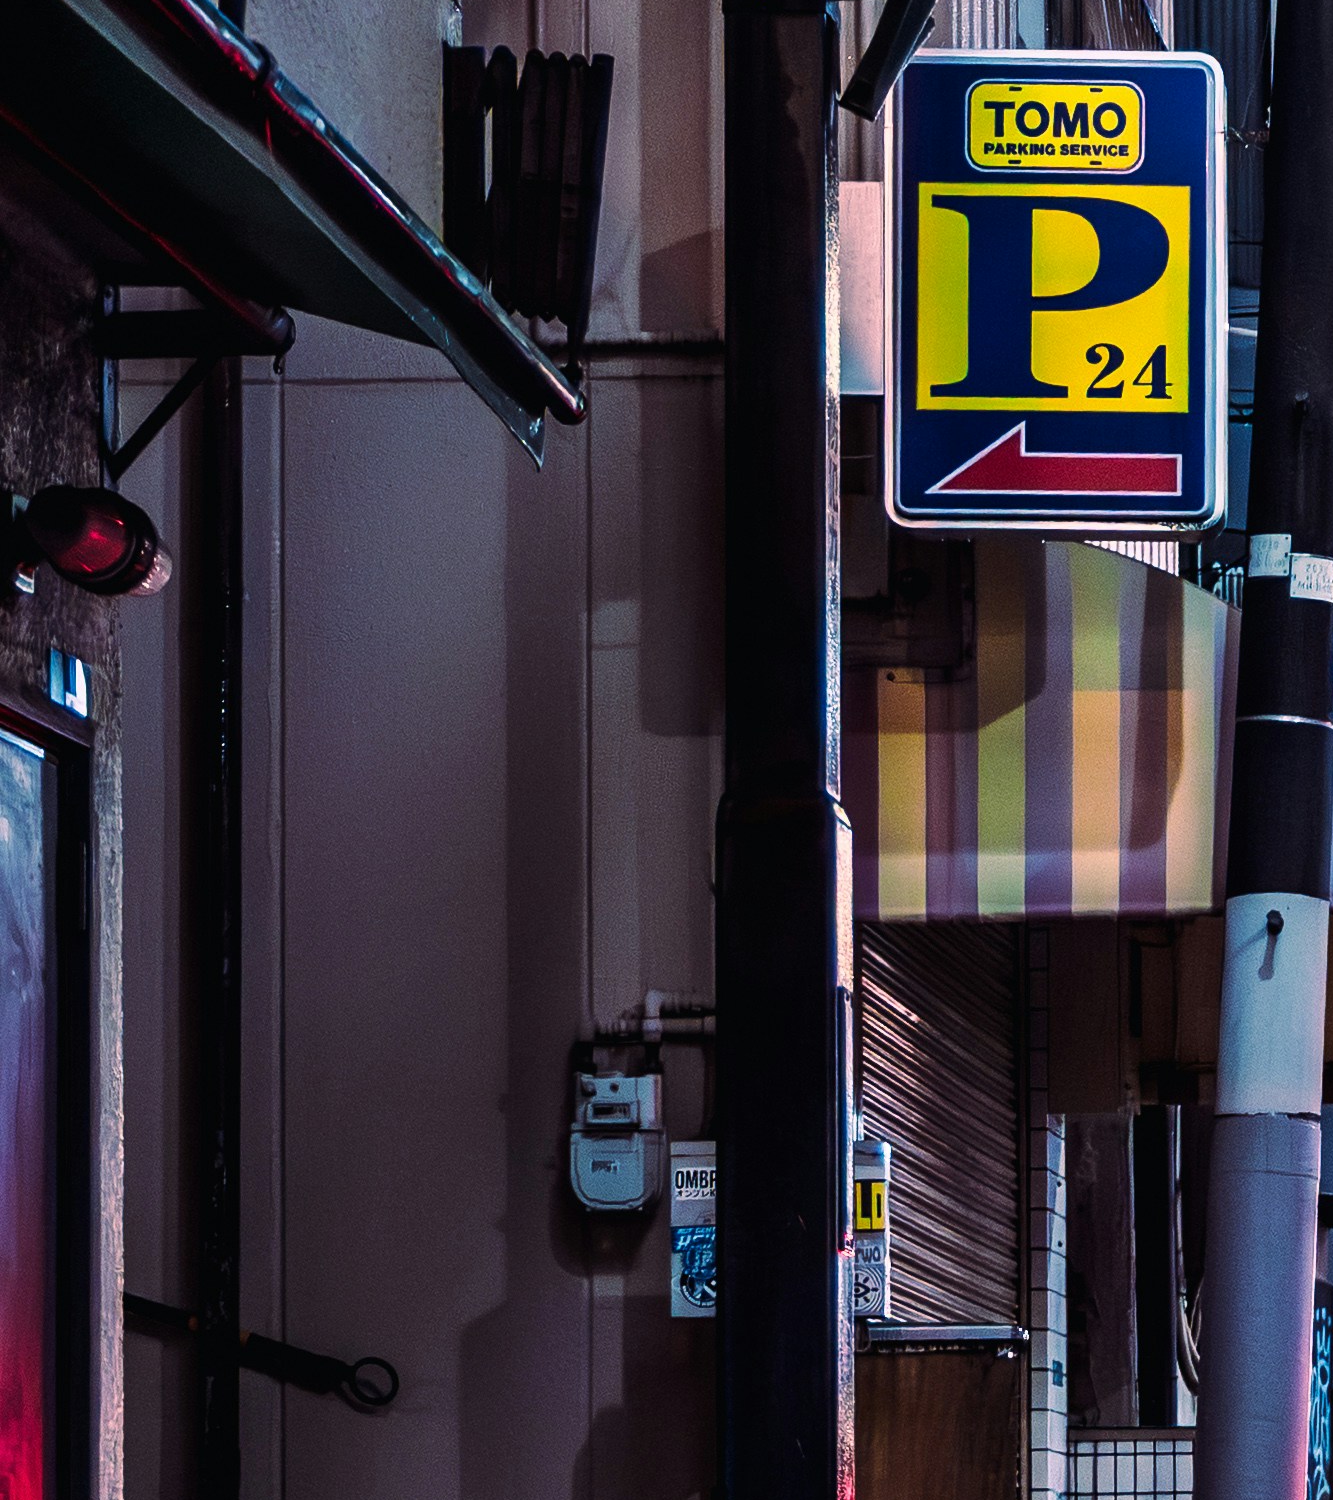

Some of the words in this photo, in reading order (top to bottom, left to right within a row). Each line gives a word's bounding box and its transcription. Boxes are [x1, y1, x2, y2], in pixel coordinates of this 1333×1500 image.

[983, 100, 1127, 140] TOMO
[983, 142, 1057, 157] PARKING
[1059, 143, 1130, 158] SERVICE
[929, 194, 1171, 399] P
[1085, 342, 1174, 400] 24
